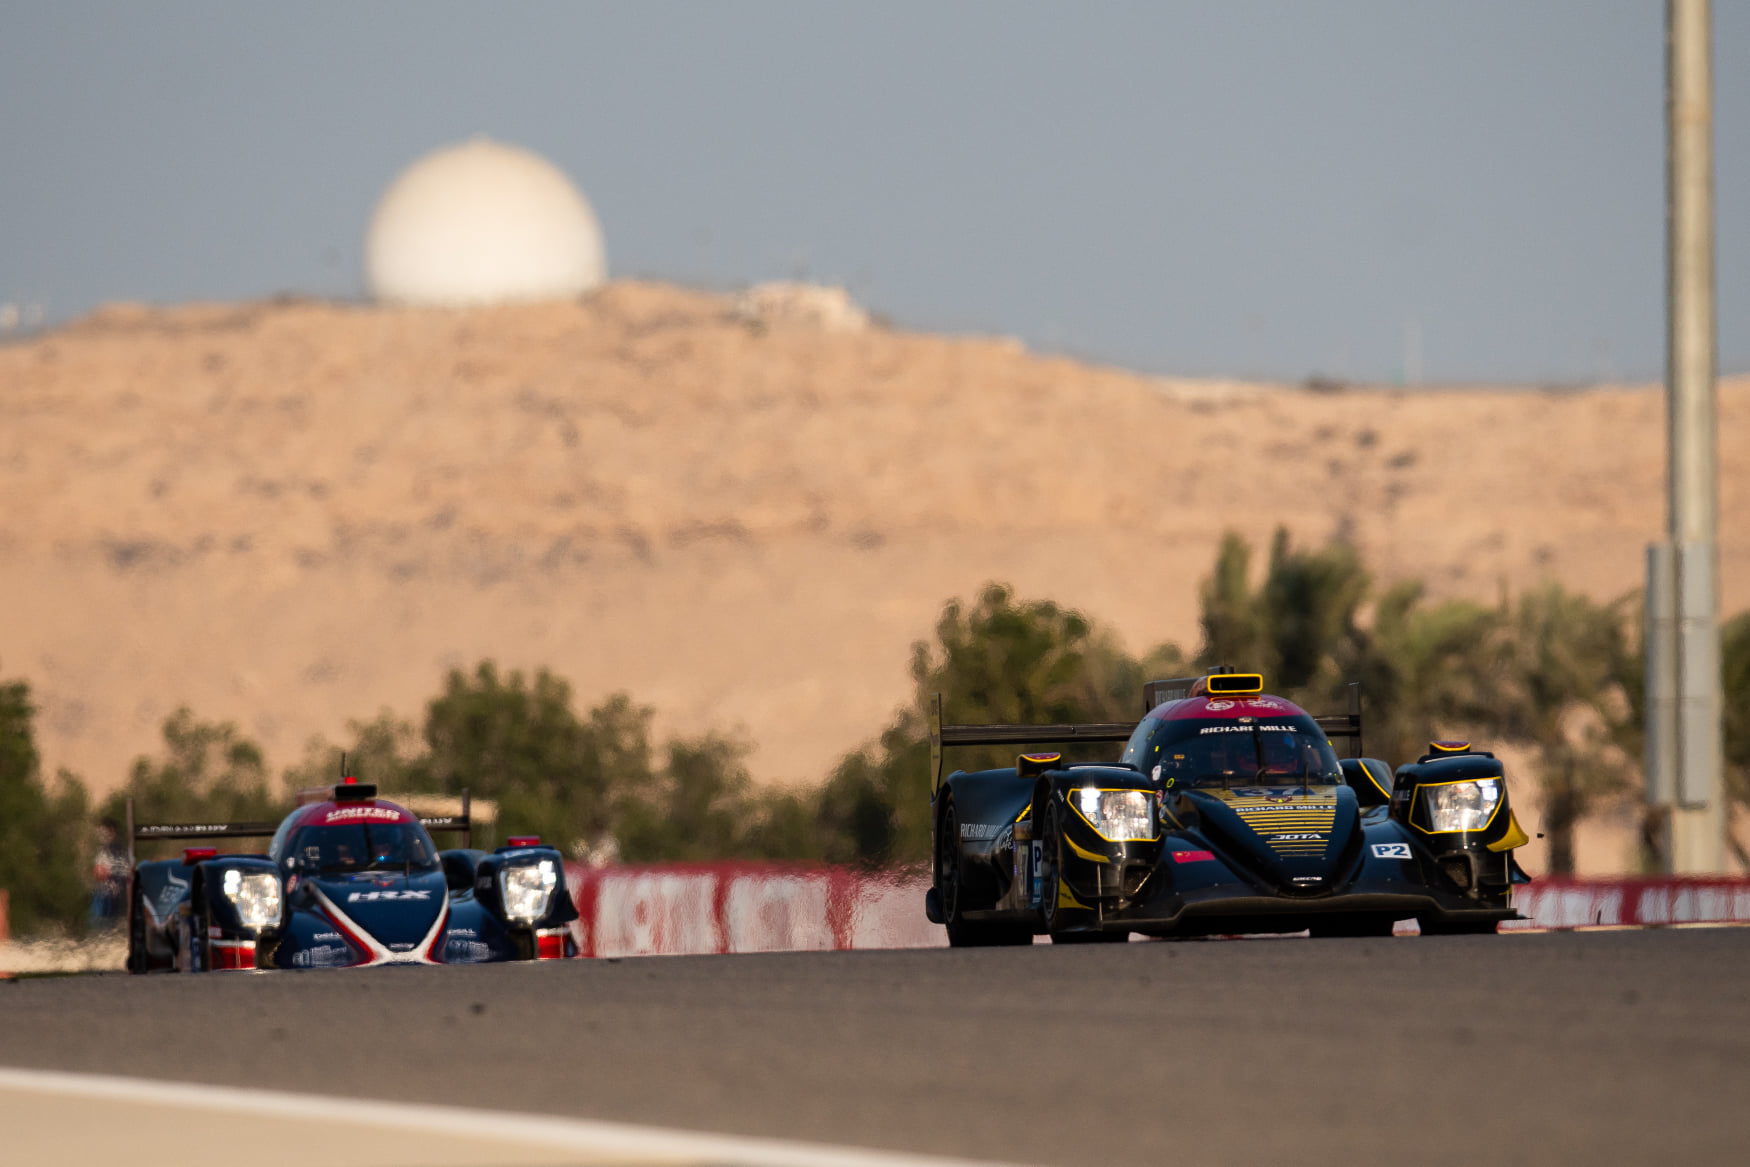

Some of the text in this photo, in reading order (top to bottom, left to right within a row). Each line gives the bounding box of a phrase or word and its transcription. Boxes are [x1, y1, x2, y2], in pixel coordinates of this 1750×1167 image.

[1270, 833, 1322, 841] JOTA
[1375, 844, 1409, 857] P2
[1034, 846, 1042, 872] P
